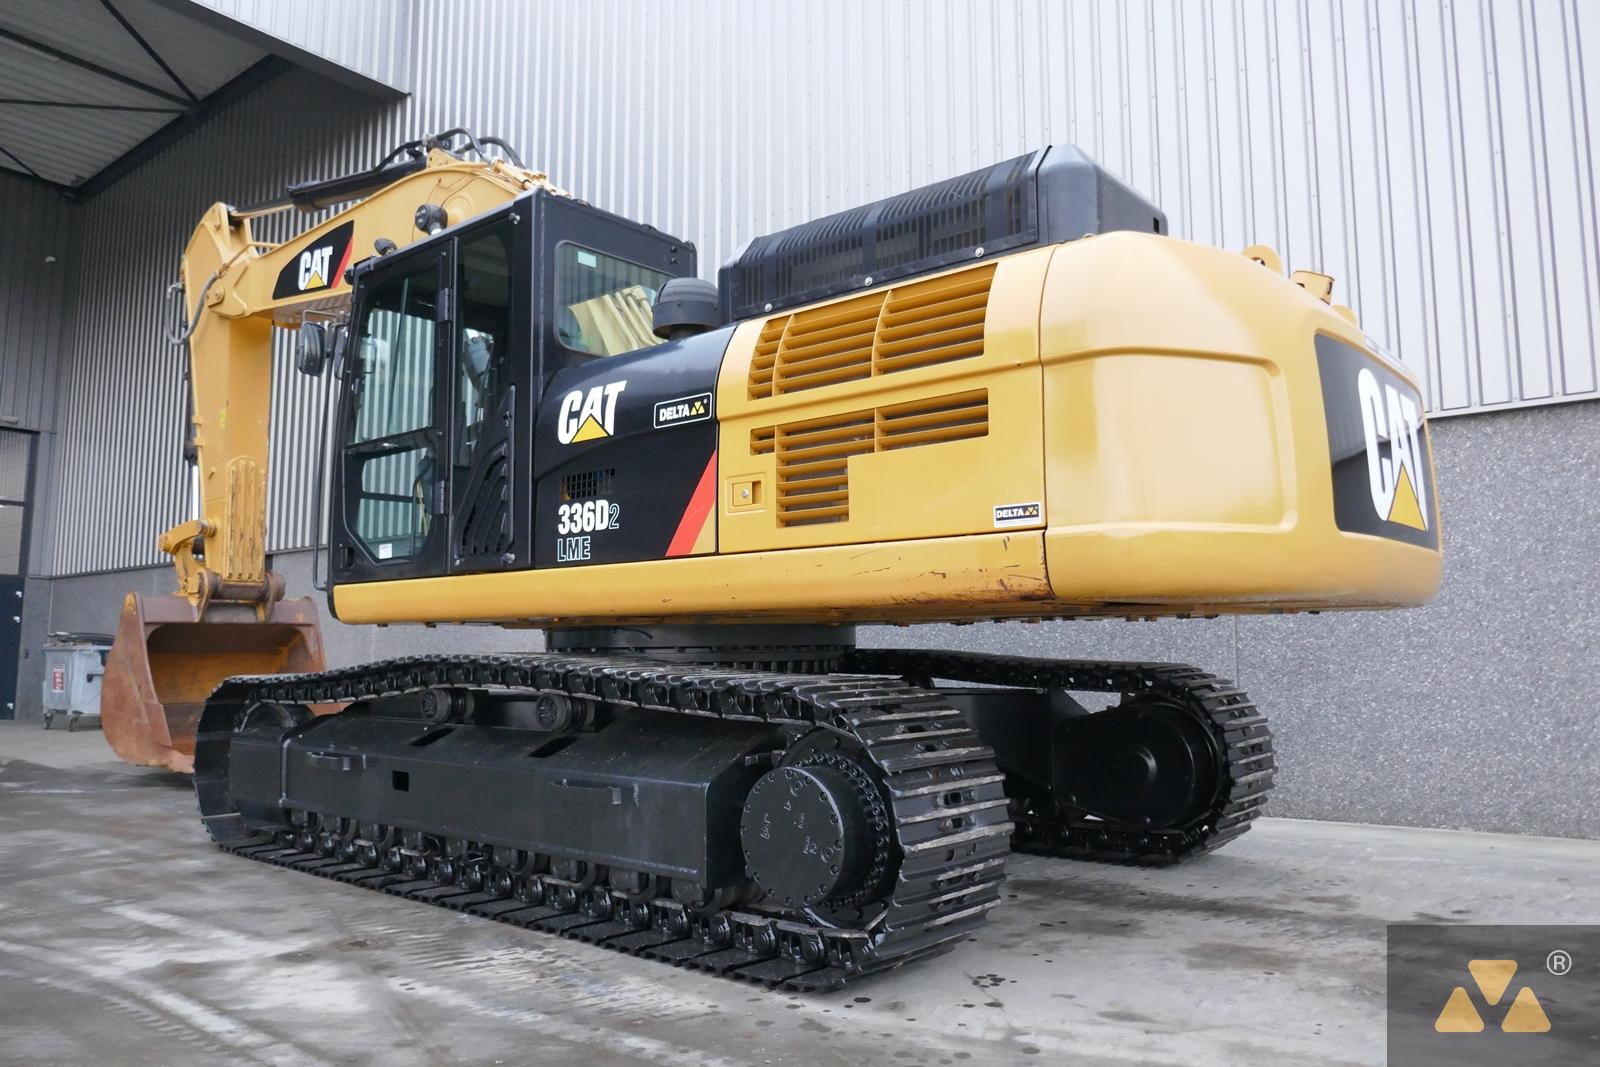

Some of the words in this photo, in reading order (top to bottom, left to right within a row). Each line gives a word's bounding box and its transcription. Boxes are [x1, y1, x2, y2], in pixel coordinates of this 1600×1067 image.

[298, 245, 334, 291] CAT
[557, 380, 628, 445] CAT
[659, 403, 690, 422] DELTA
[1358, 368, 1429, 531] CAT
[557, 500, 620, 535] 336D2
[996, 507, 1025, 519] DELTA
[557, 536, 591, 562] LME
